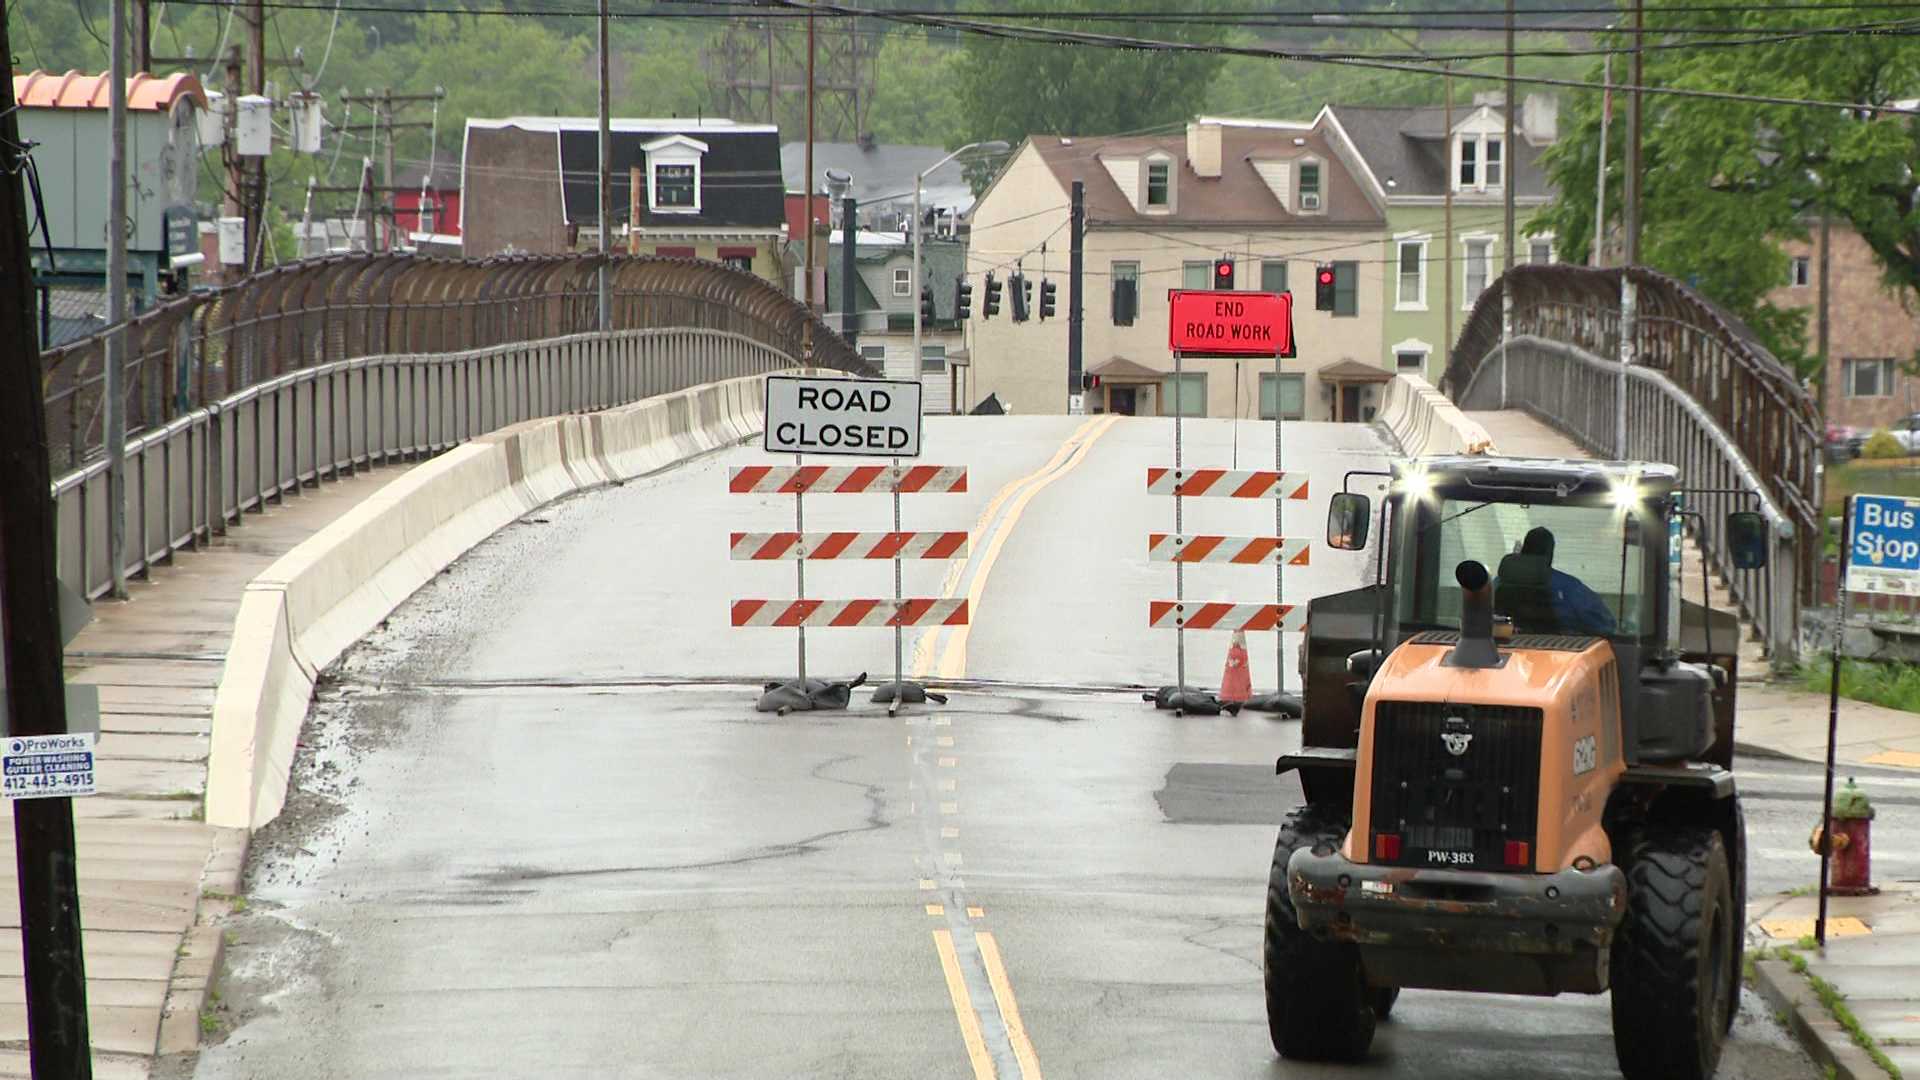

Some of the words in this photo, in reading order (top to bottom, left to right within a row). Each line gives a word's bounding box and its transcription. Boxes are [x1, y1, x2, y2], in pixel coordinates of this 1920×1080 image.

[1215, 301, 1244, 317] END
[1186, 322, 1225, 339] ROAD
[1231, 324, 1272, 340] WORK
[798, 387, 891, 413] ROAD
[776, 422, 909, 449] CLOSED
[1863, 503, 1915, 529] Bus
[1856, 531, 1919, 563] Stop
[27, 737, 85, 750] ProWorks
[6, 765, 43, 775] GUTTER
[44, 761, 91, 772] CLEANING
[9, 756, 42, 766] POWER
[43, 753, 87, 763] WASHING
[4, 773, 94, 790] 412-443-4915
[1427, 850, 1475, 864] PW-383
